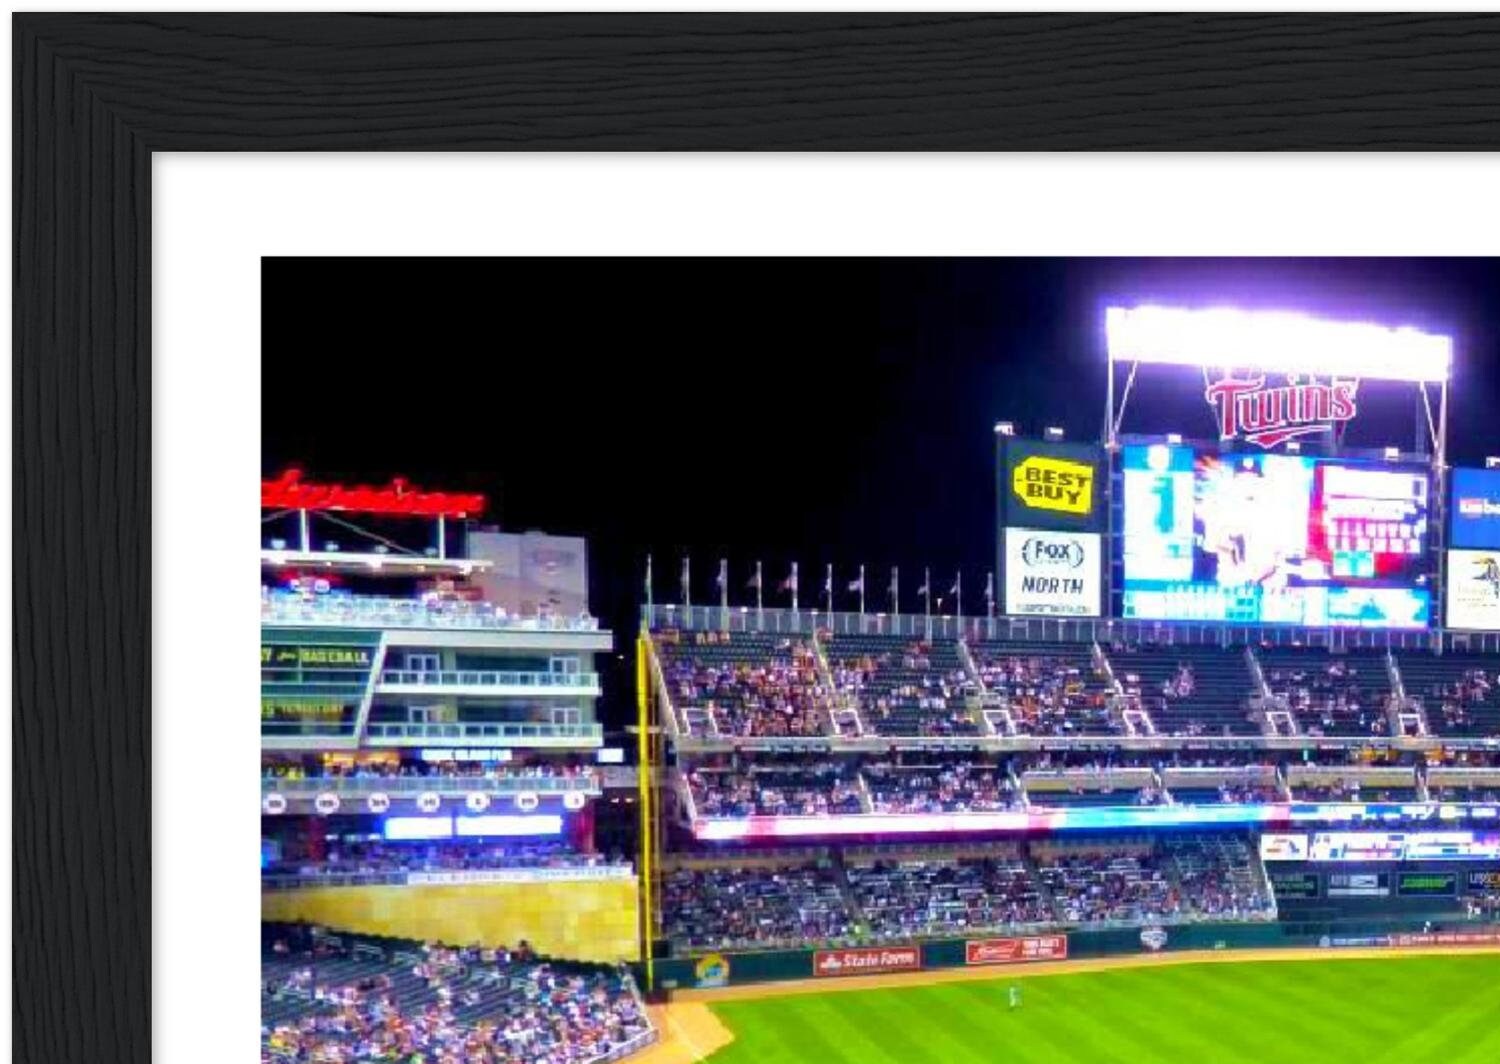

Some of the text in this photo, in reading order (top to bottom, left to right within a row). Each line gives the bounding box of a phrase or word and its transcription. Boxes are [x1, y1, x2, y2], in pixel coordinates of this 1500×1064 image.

[1205, 376, 1357, 441] Twins
[1025, 466, 1089, 488] BEST
[1026, 482, 1081, 505] BUY
[1022, 575, 1084, 594] NORTH
